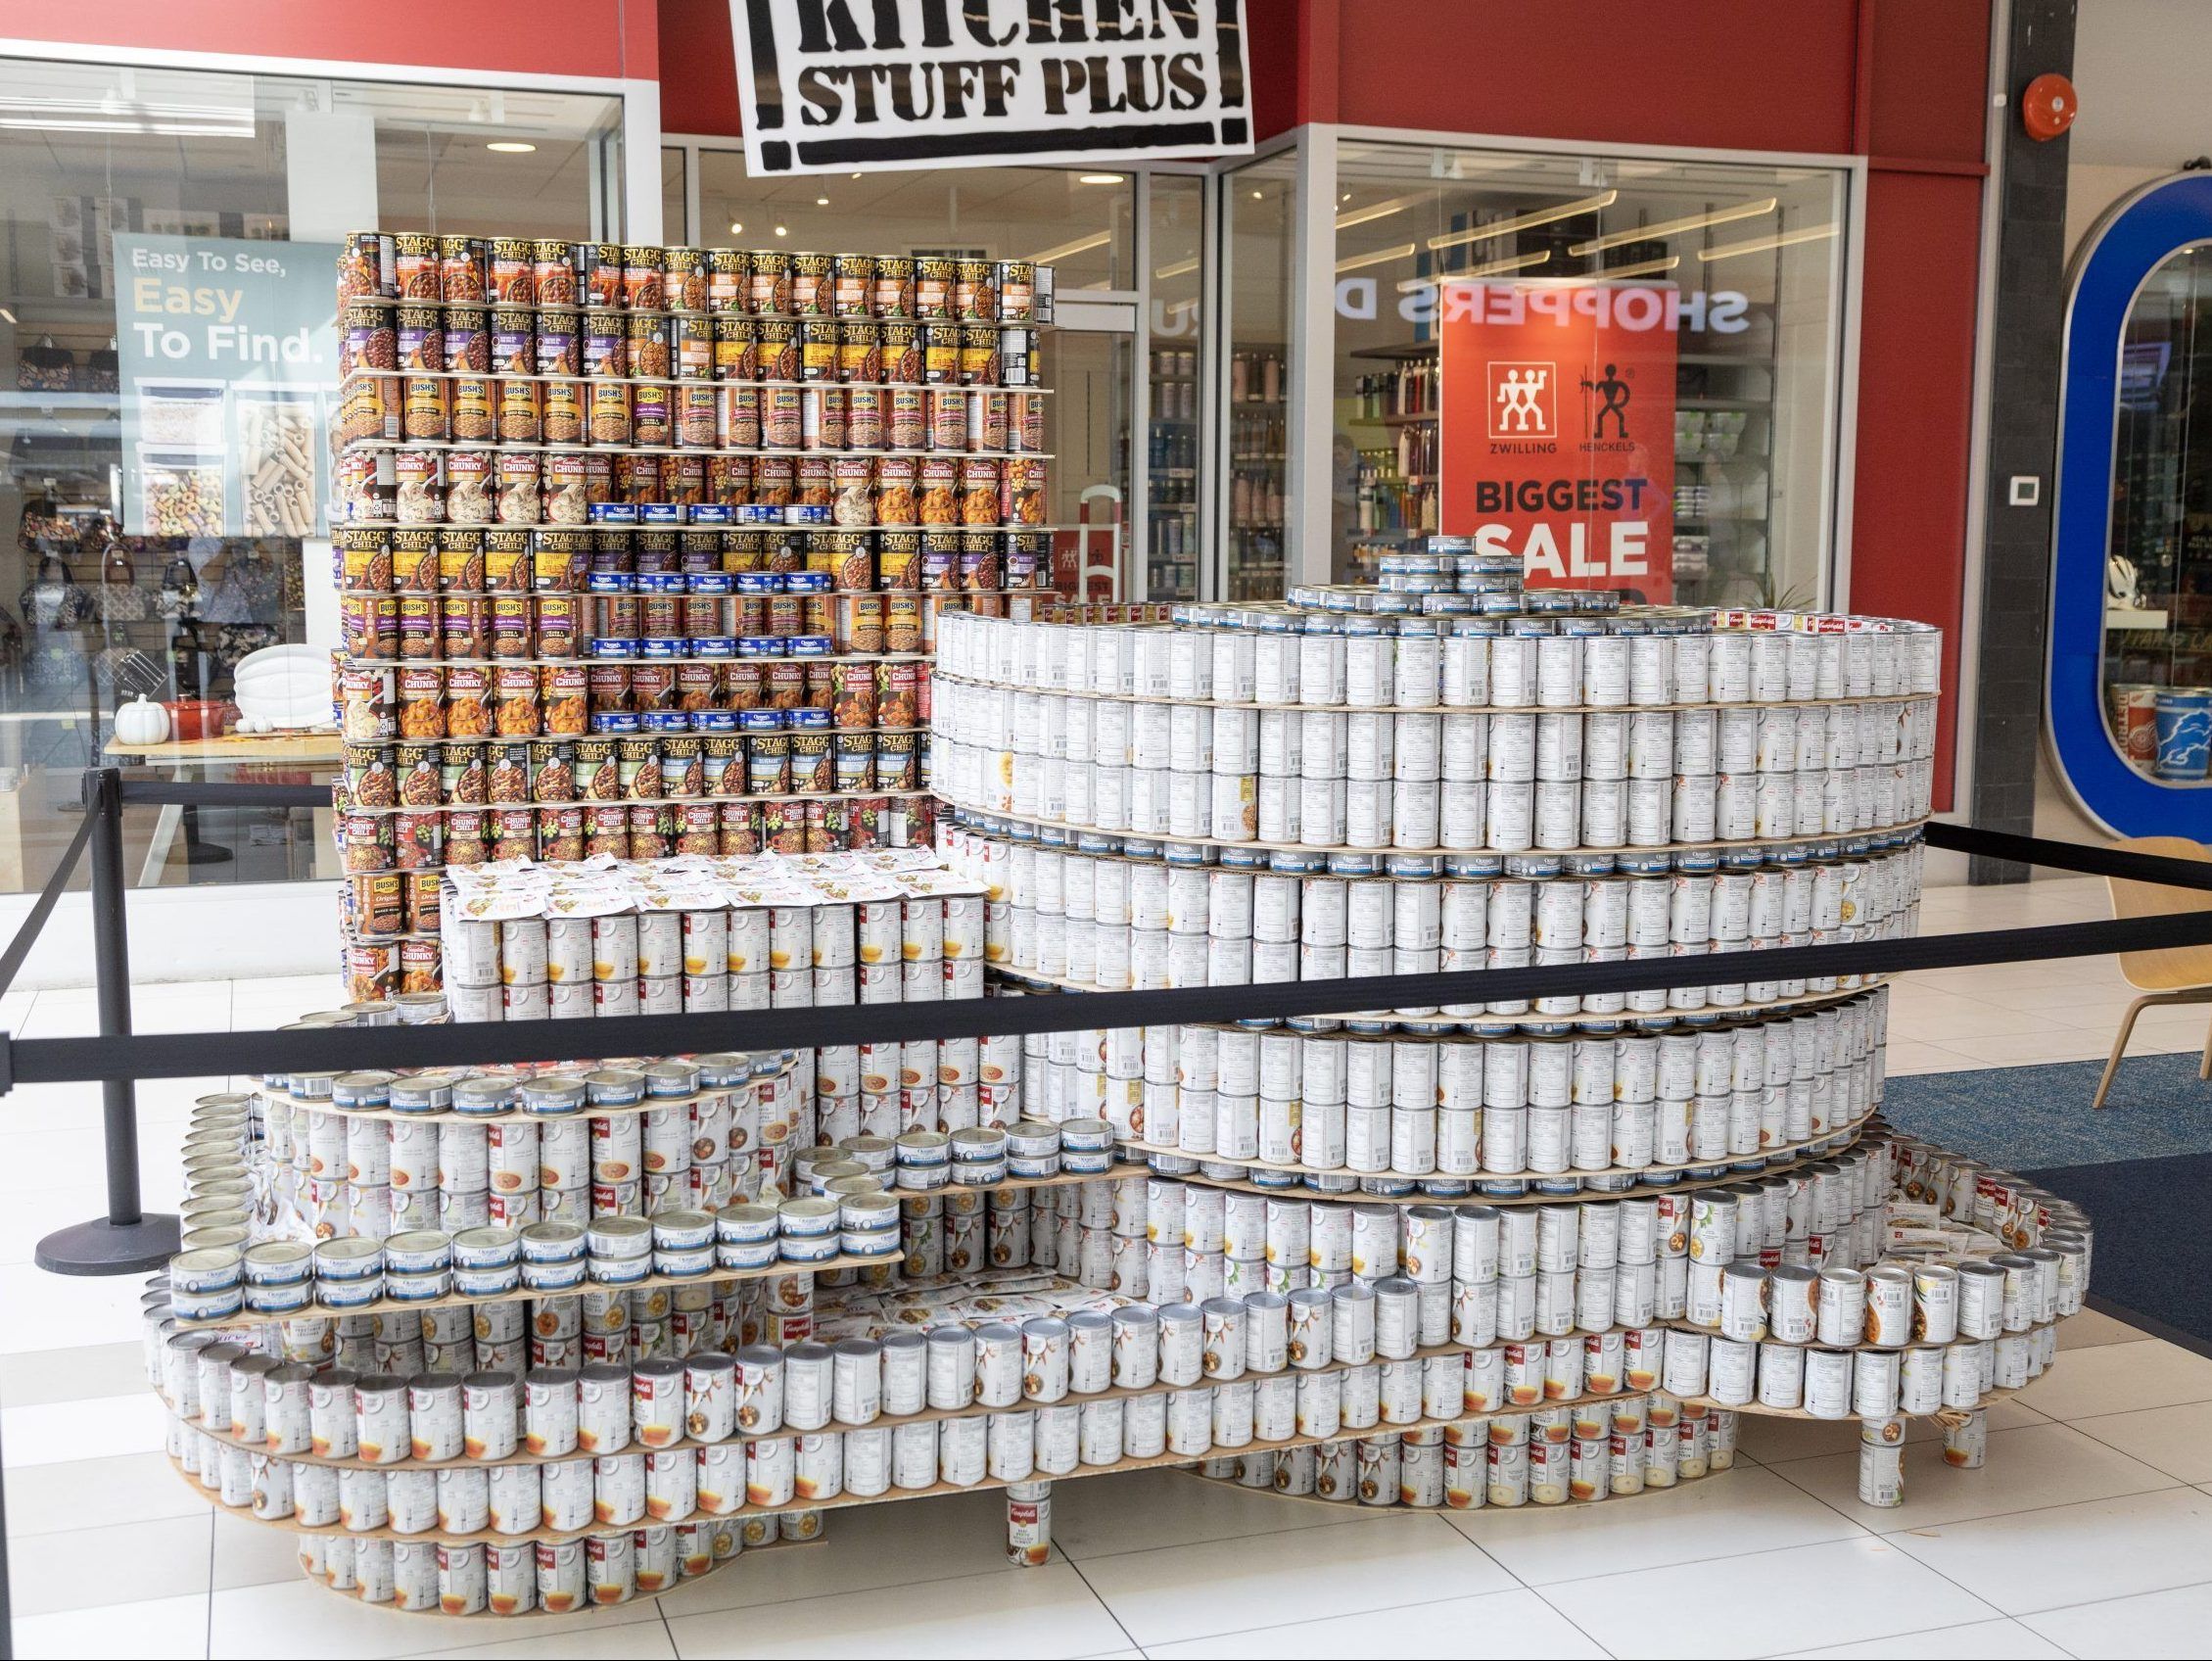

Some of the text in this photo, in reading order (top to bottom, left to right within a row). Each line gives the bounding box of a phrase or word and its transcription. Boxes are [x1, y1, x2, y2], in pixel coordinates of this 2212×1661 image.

[799, 53, 1206, 125] STUFF PLUS
[397, 237, 435, 249] STAGG
[624, 249, 661, 261] STAGG
[133, 249, 286, 277] Easy To See,
[134, 278, 243, 322] Easy
[399, 310, 438, 323] STAGG
[445, 310, 483, 324] STAGG
[133, 322, 322, 362] To Find.
[639, 391, 662, 400] BUSH'S
[1490, 444, 1557, 453] ZWILLING
[1580, 443, 1634, 451] HENCKELS
[448, 461, 482, 471] CHUNKY
[504, 462, 536, 471] CHUNKY
[837, 468, 867, 477] CHUNKY
[1477, 479, 1647, 512] BIGGEST
[346, 531, 386, 542] STAGG
[396, 532, 435, 543] STAGG
[442, 532, 482, 544] STAGG
[1476, 521, 1648, 579] SALE
[405, 680, 438, 688] CHUNKY
[591, 674, 622, 683] CHUNKY
